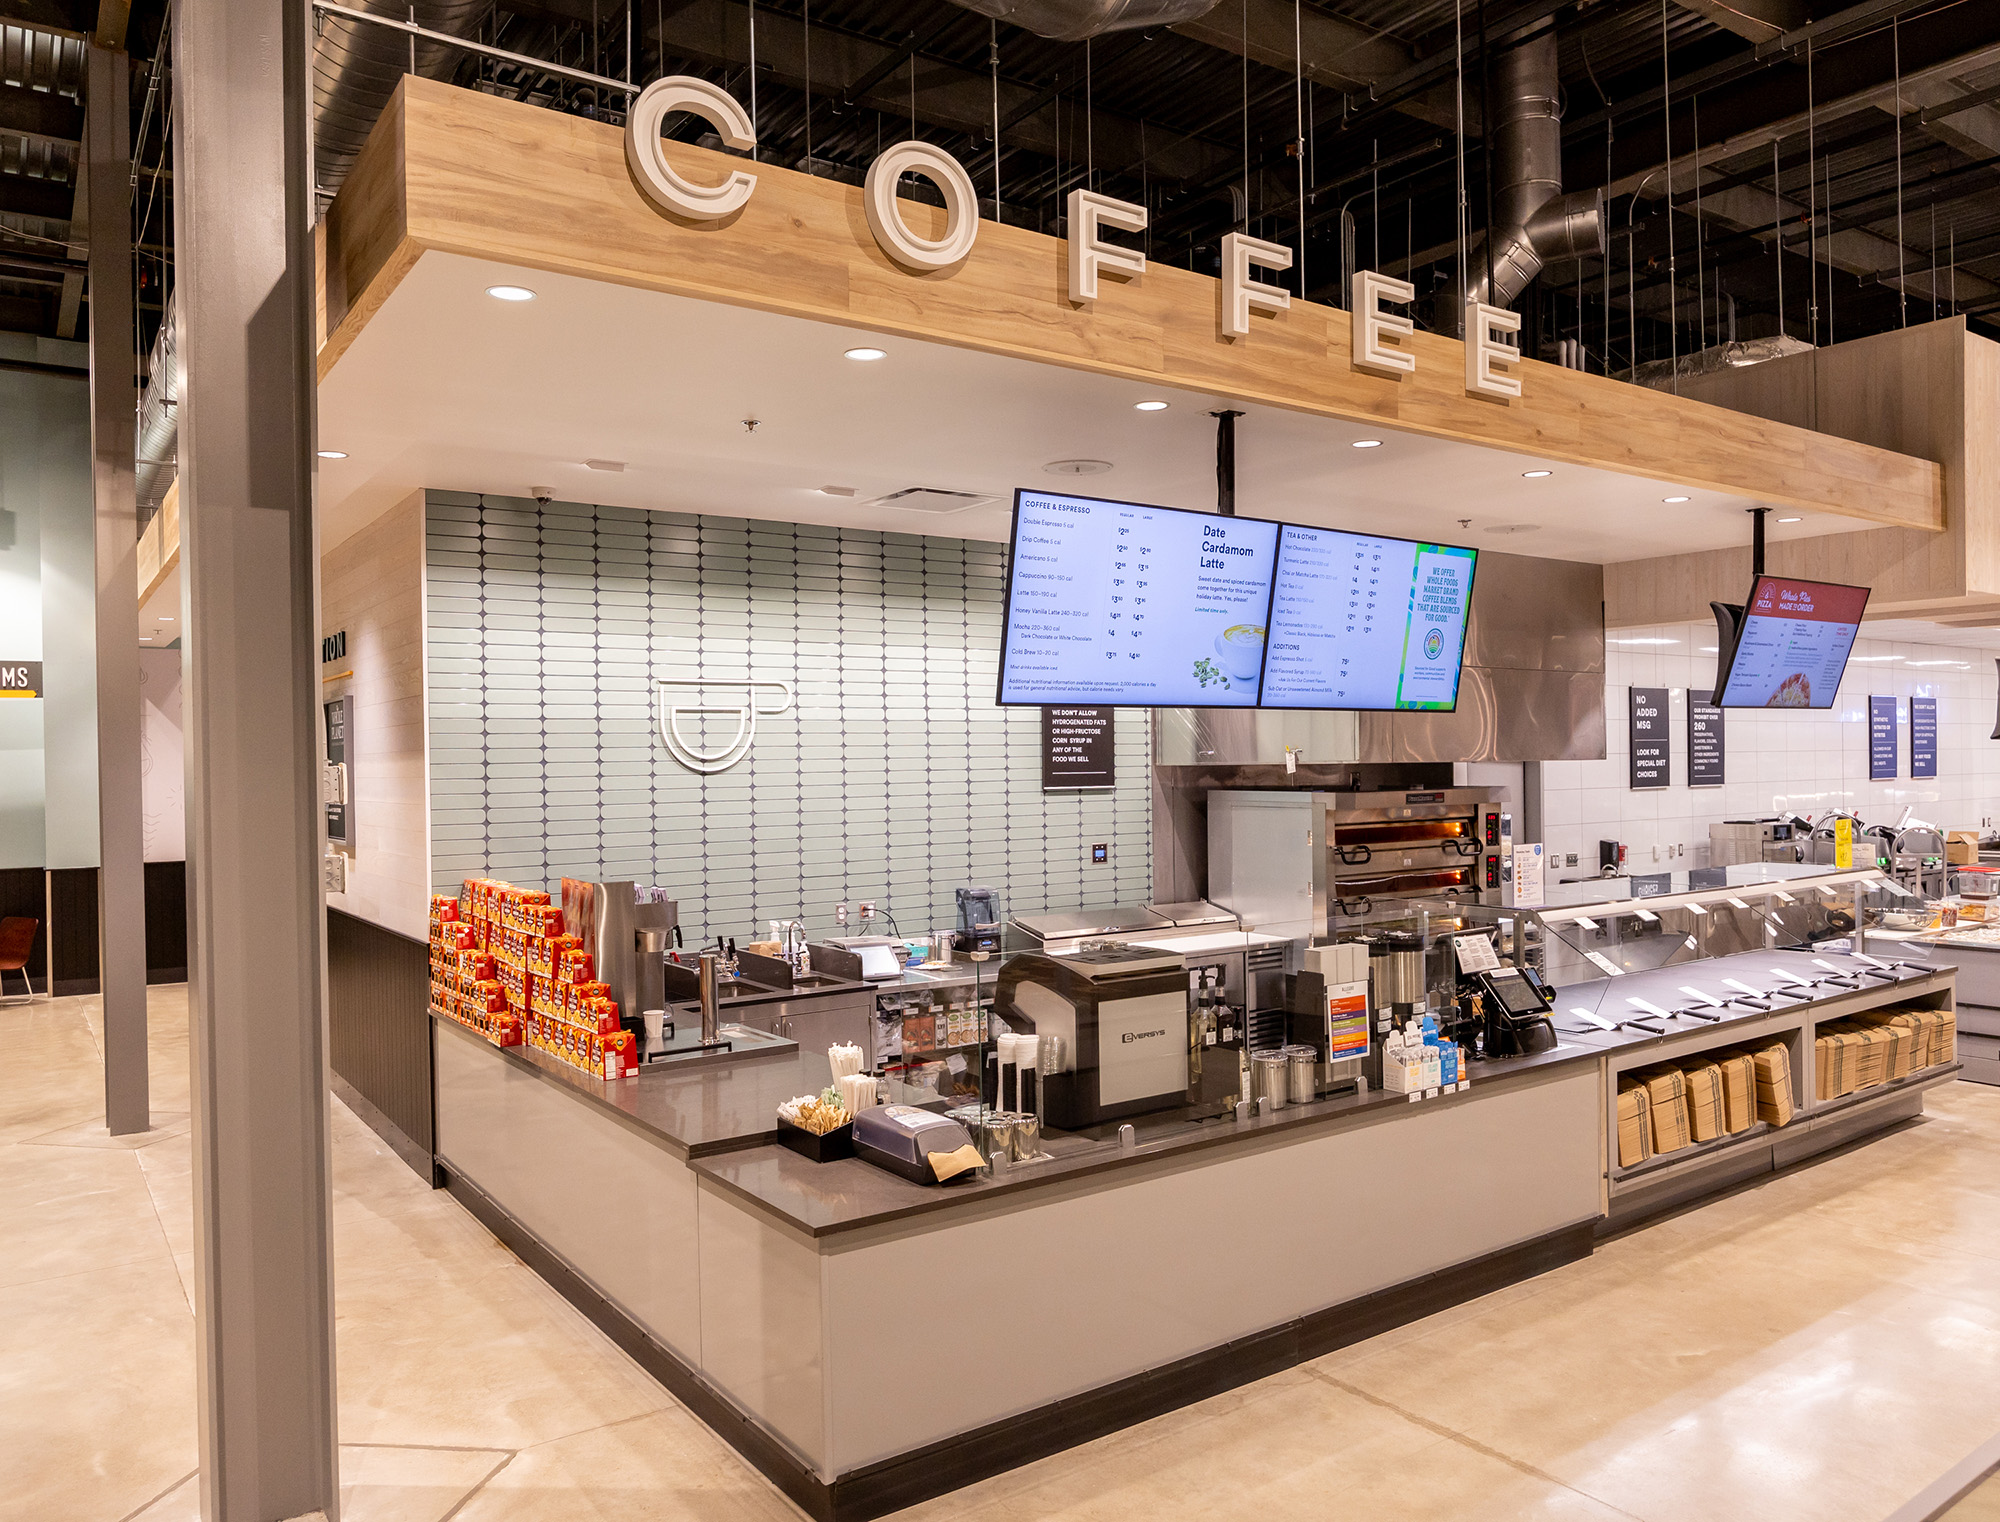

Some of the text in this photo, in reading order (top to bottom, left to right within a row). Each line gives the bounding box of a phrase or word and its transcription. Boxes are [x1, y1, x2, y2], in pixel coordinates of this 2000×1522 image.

[624, 74, 1523, 399] COFFEE
[1025, 500, 1050, 510] COFFEE
[1058, 504, 1090, 514] ESPRESSO
[1042, 520, 1062, 528] Espresso
[1203, 525, 1226, 538] Date
[1202, 541, 1254, 556] Cardamom
[1020, 554, 1046, 562] Americano
[1200, 556, 1224, 569] Latte
[1018, 572, 1048, 580] Cappuccino
[1427, 577, 1443, 585] WHOLE
[1424, 586, 1443, 594] MARKET
[1756, 600, 1772, 608] PIZZA
[1778, 602, 1793, 610] MADE
[1797, 603, 1814, 612] ORDER
[1015, 607, 1031, 615] Honey
[1273, 643, 1300, 651] ADDITIONS
[2, 667, 28, 688] MS
[1636, 696, 1646, 704] NO
[1636, 708, 1657, 716] ADDED
[1636, 721, 1651, 729] MSG
[1694, 722, 1706, 730] 260
